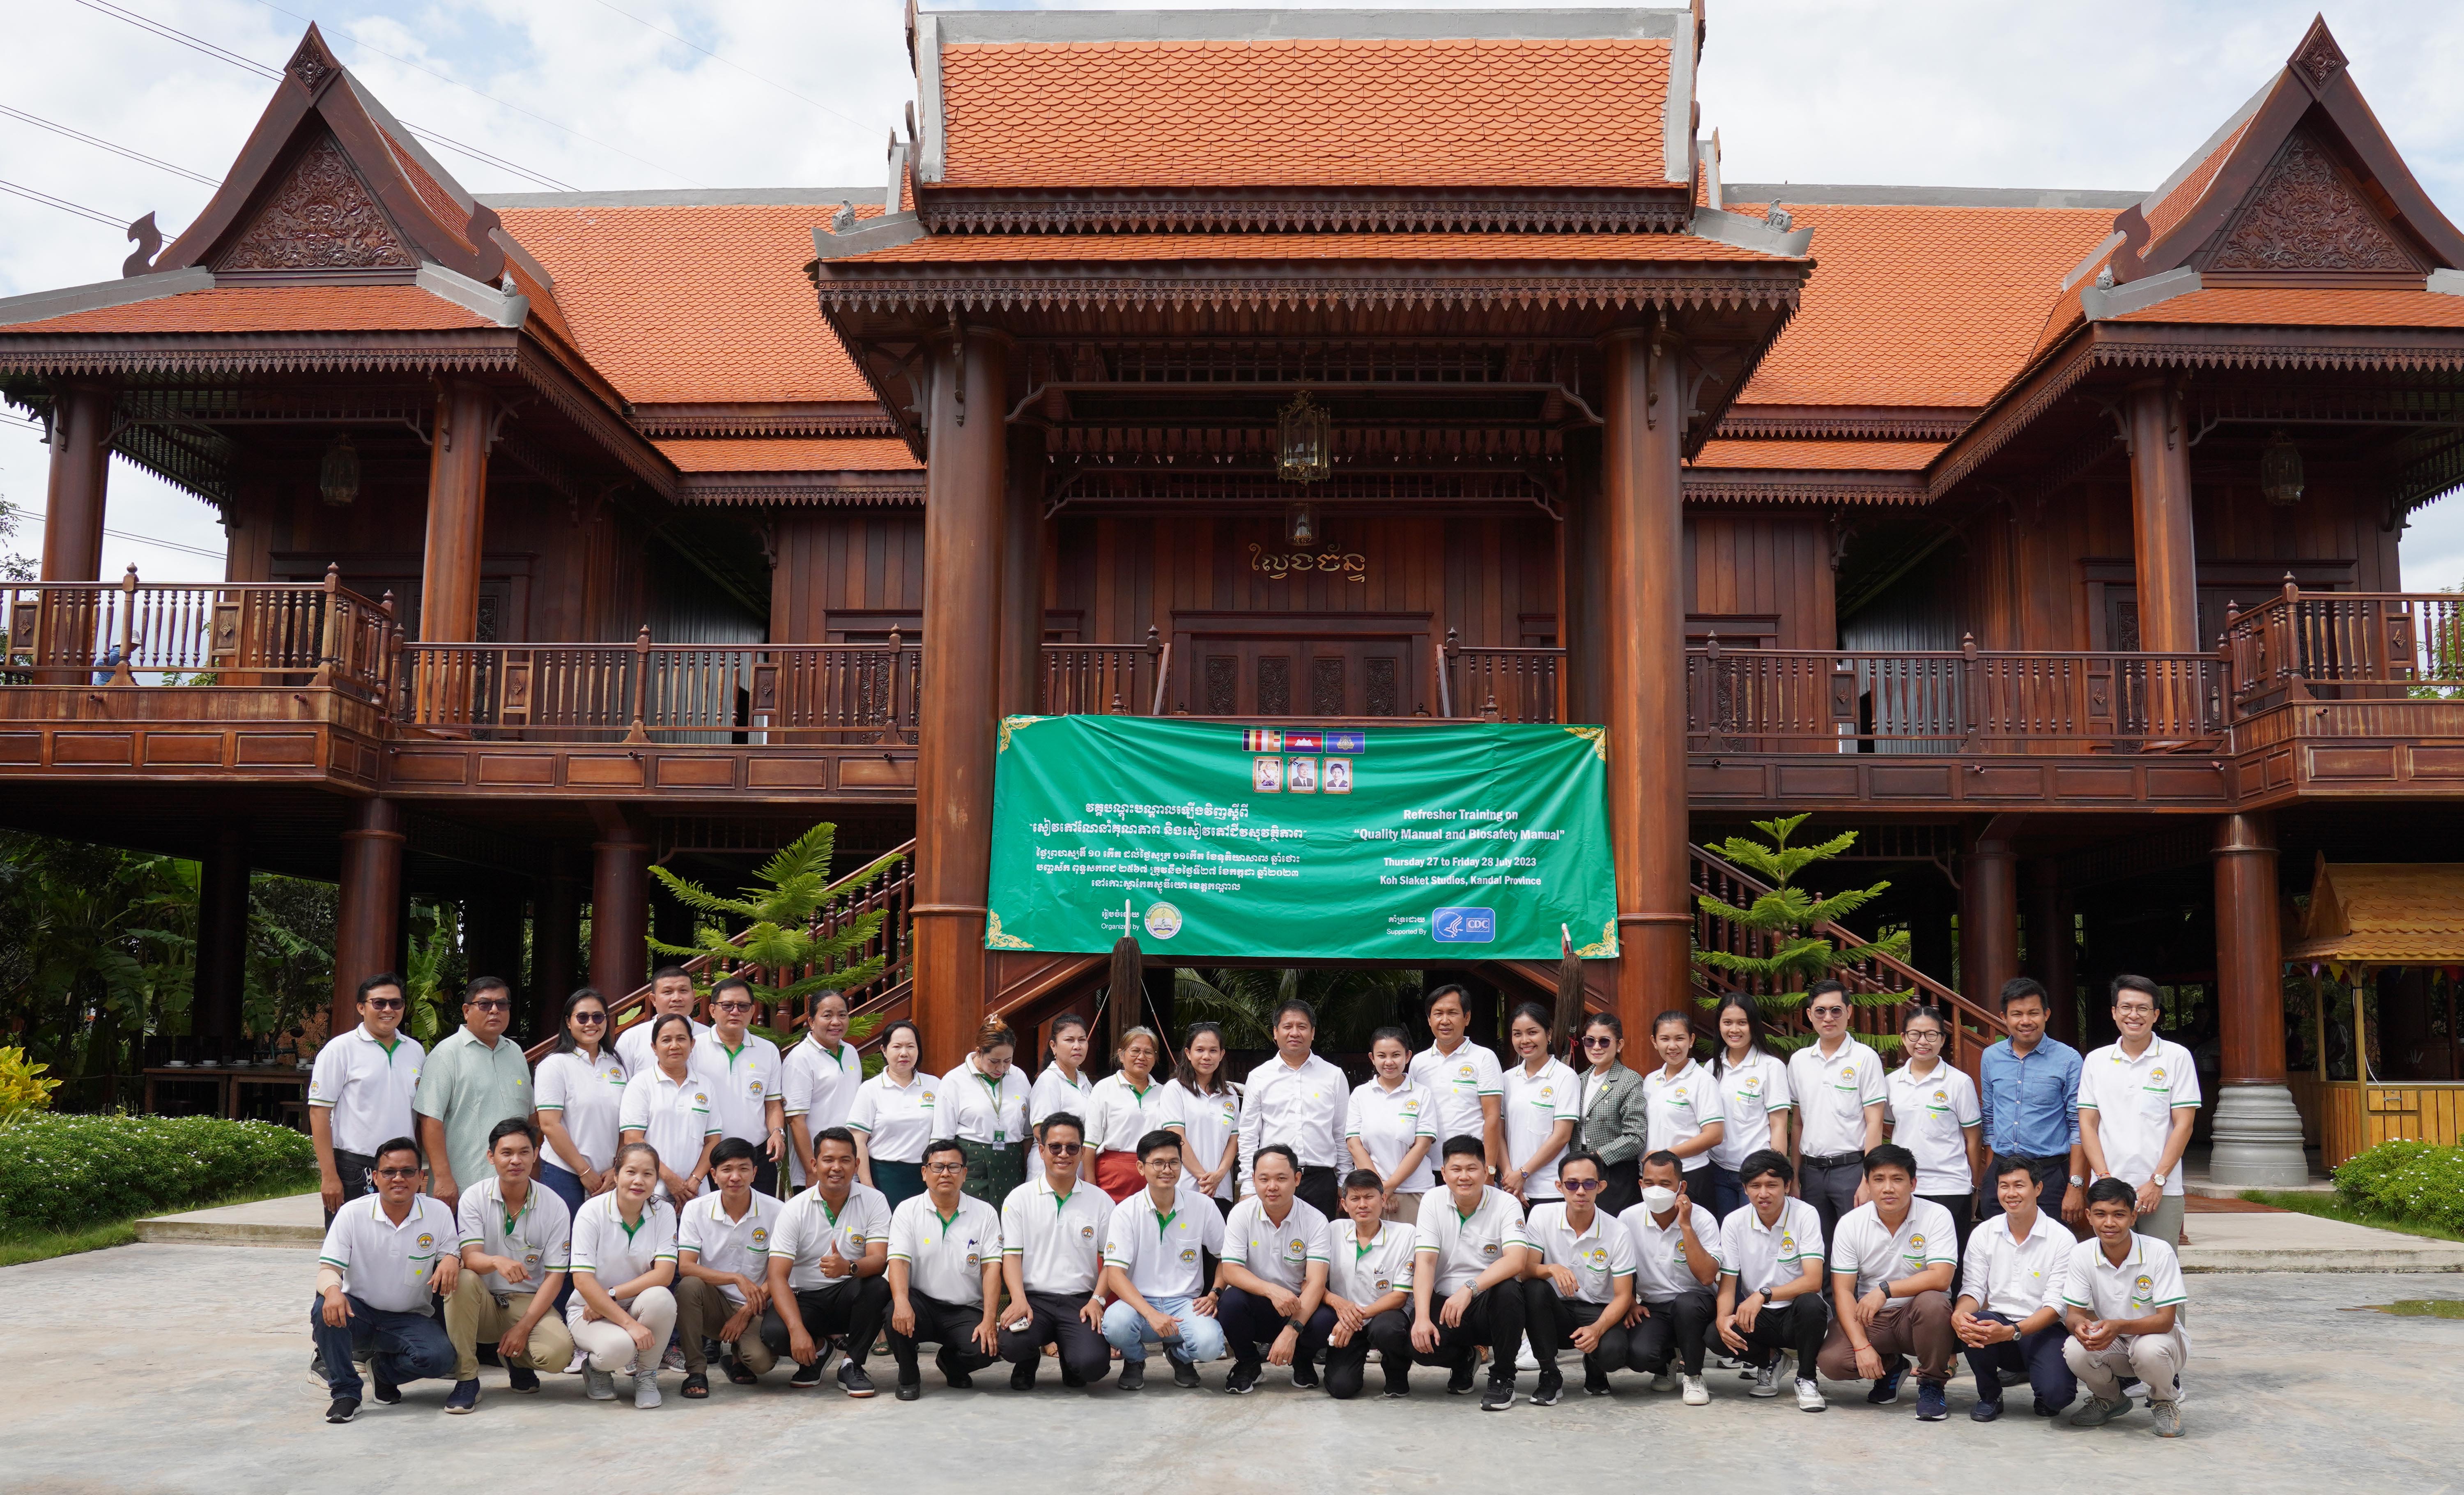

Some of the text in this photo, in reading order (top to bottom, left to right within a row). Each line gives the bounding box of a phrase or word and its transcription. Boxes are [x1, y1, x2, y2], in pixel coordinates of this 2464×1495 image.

[1403, 809, 1518, 822] Refresher Training on
[1354, 828, 1565, 842] “Quality Manual and Biosafety Manual”
[1384, 857, 1536, 868] Thursday 27 to Friday 28 July 2023
[1119, 865, 1147, 873] ២៥៦៧
[1380, 876, 1541, 886] Koh Slaket Studios, Kandal Province
[1467, 920, 1489, 929] CDC
